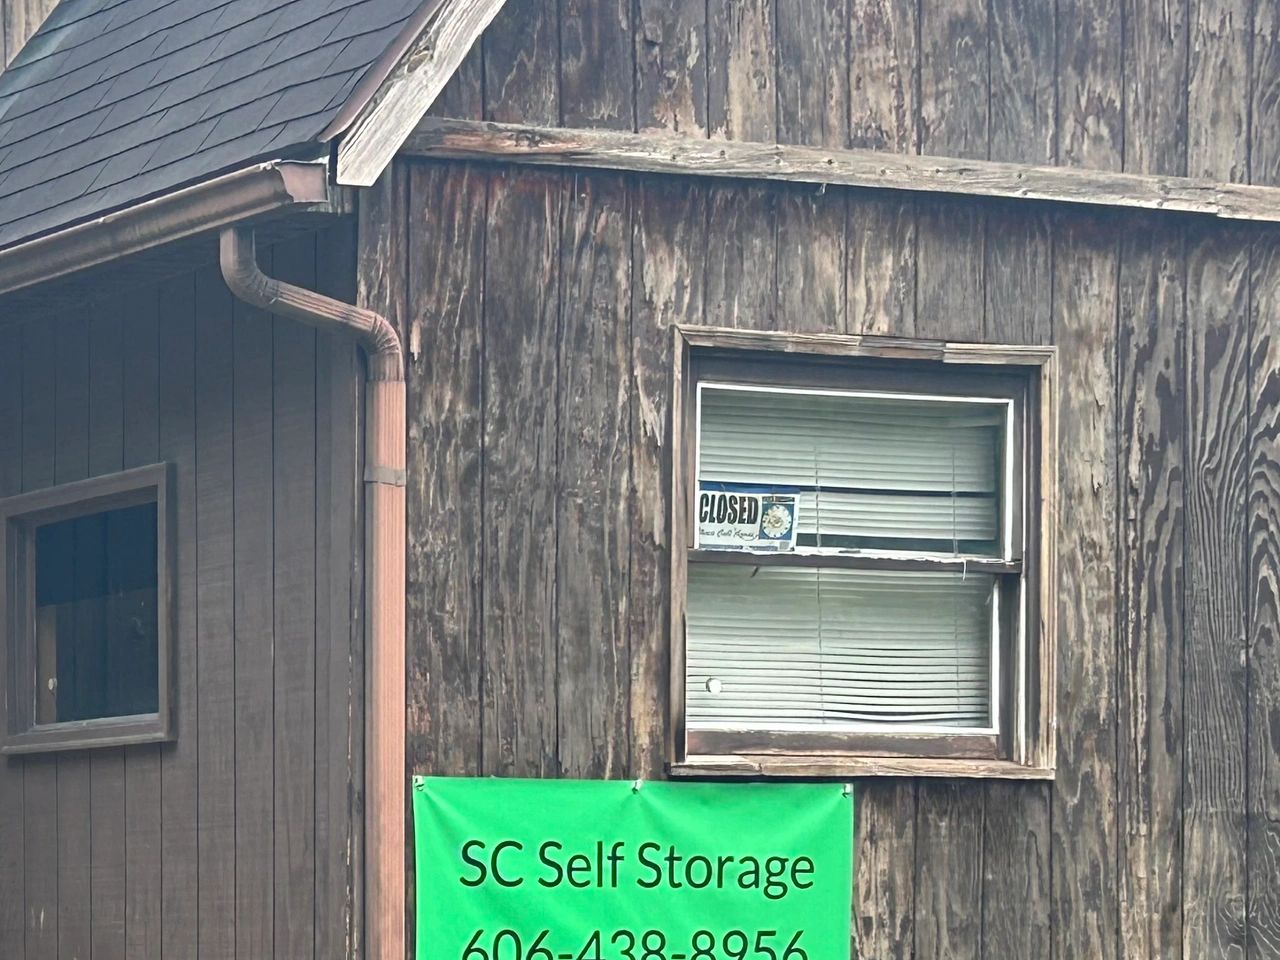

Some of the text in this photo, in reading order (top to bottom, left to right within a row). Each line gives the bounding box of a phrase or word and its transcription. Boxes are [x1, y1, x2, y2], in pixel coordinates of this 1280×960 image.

[699, 493, 759, 525] CLOSED
[459, 839, 816, 901] SC Self Storage
